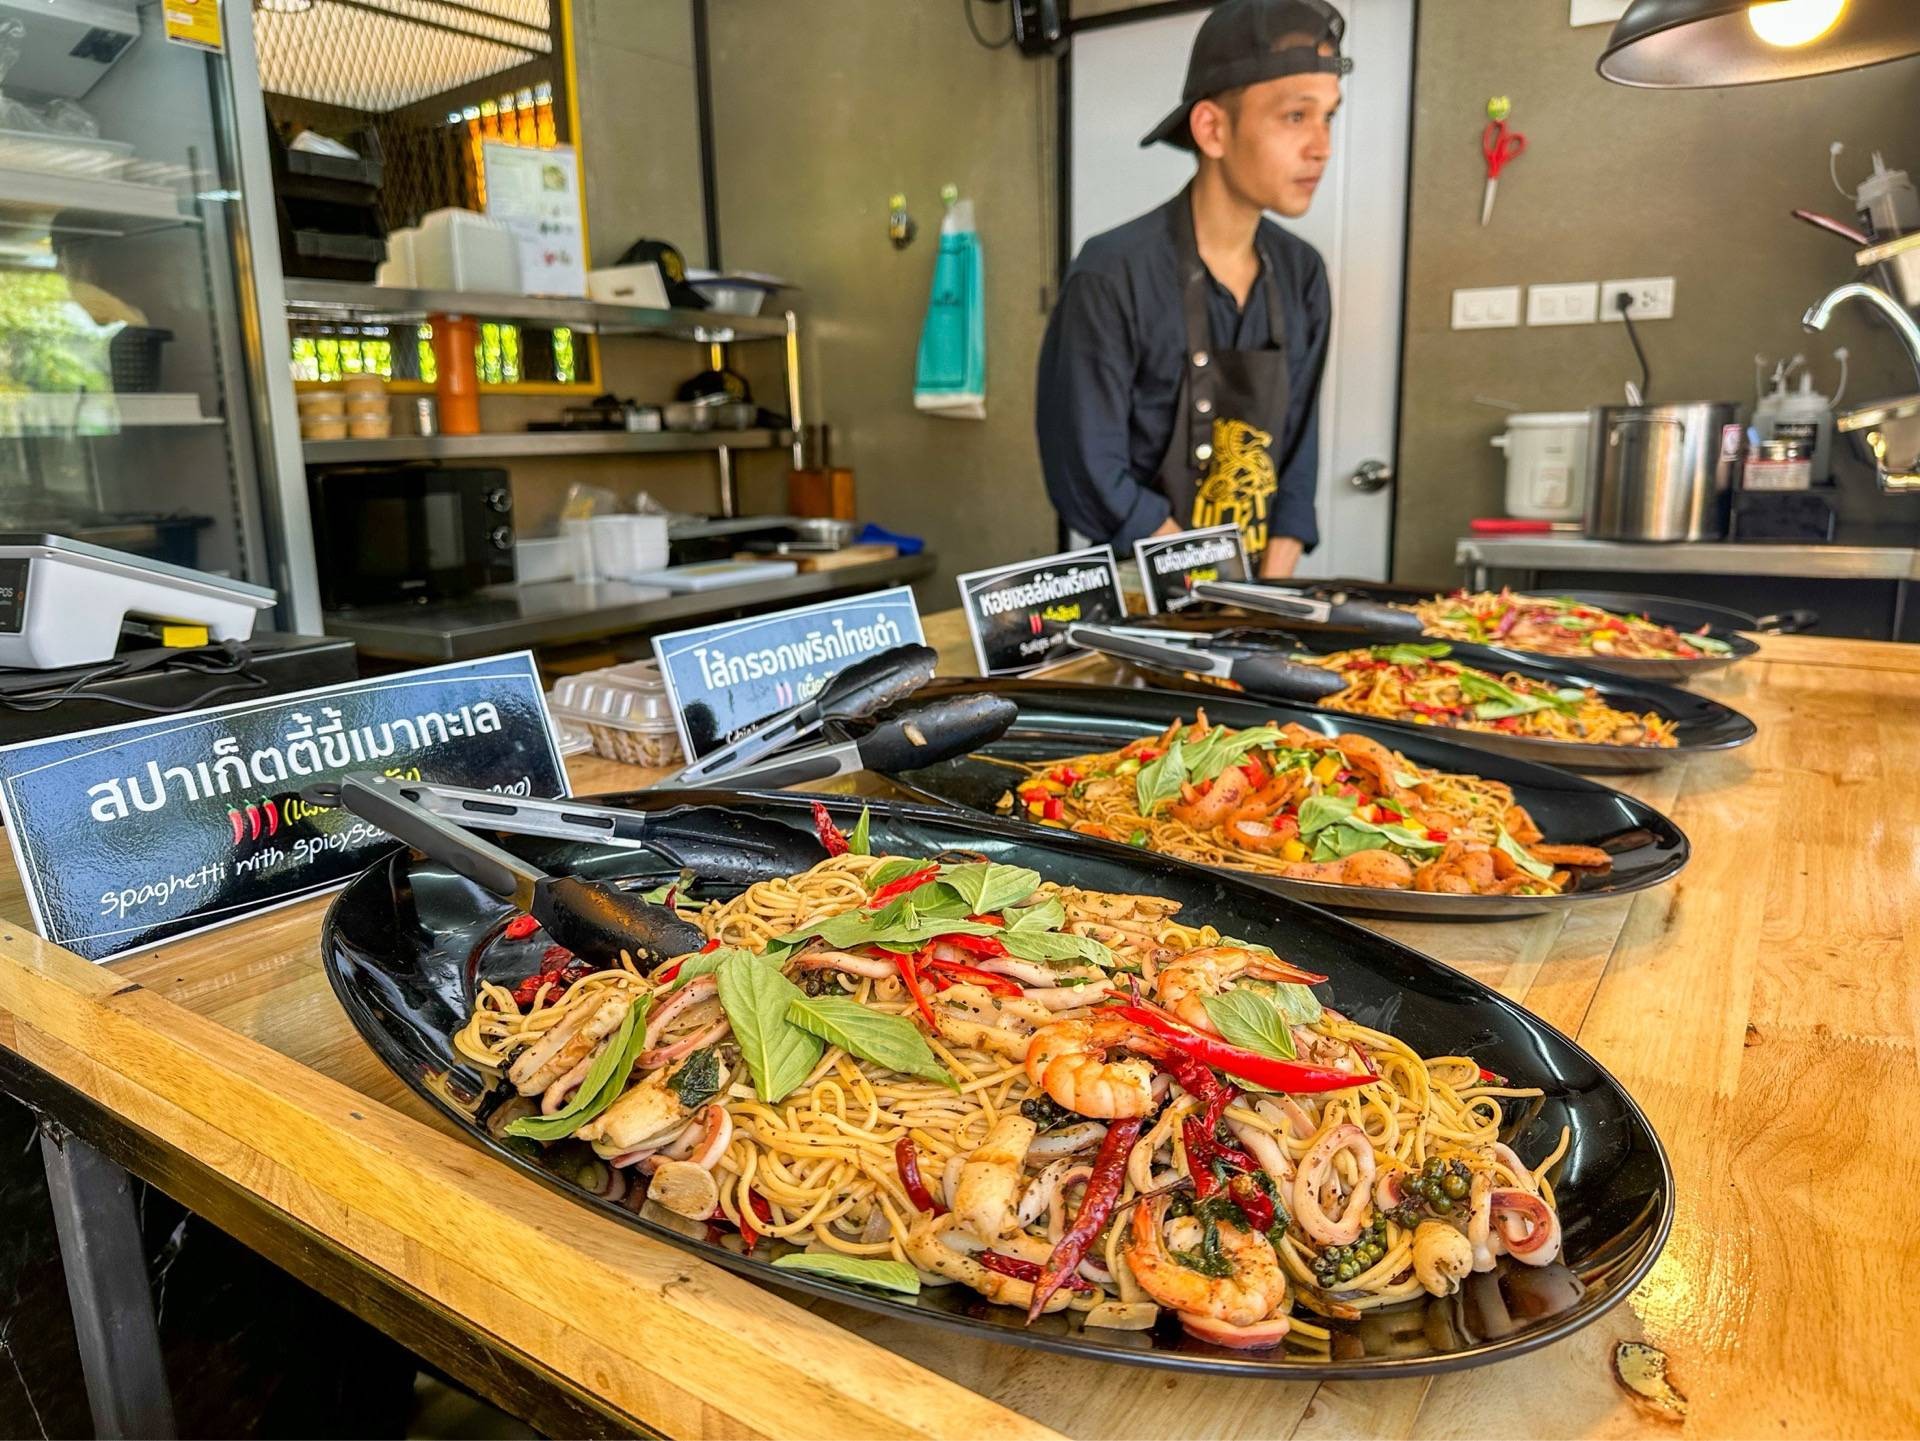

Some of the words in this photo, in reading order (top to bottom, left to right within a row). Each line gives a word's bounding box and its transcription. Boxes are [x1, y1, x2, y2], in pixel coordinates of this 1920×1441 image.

[693, 612, 901, 690] ไส้กรอกพริกไทยดำ
[86, 700, 502, 823] สปาเก็ตตี้ขี้เมาทะเล
[100, 861, 226, 917] Spaghetti
[236, 846, 285, 876] with
